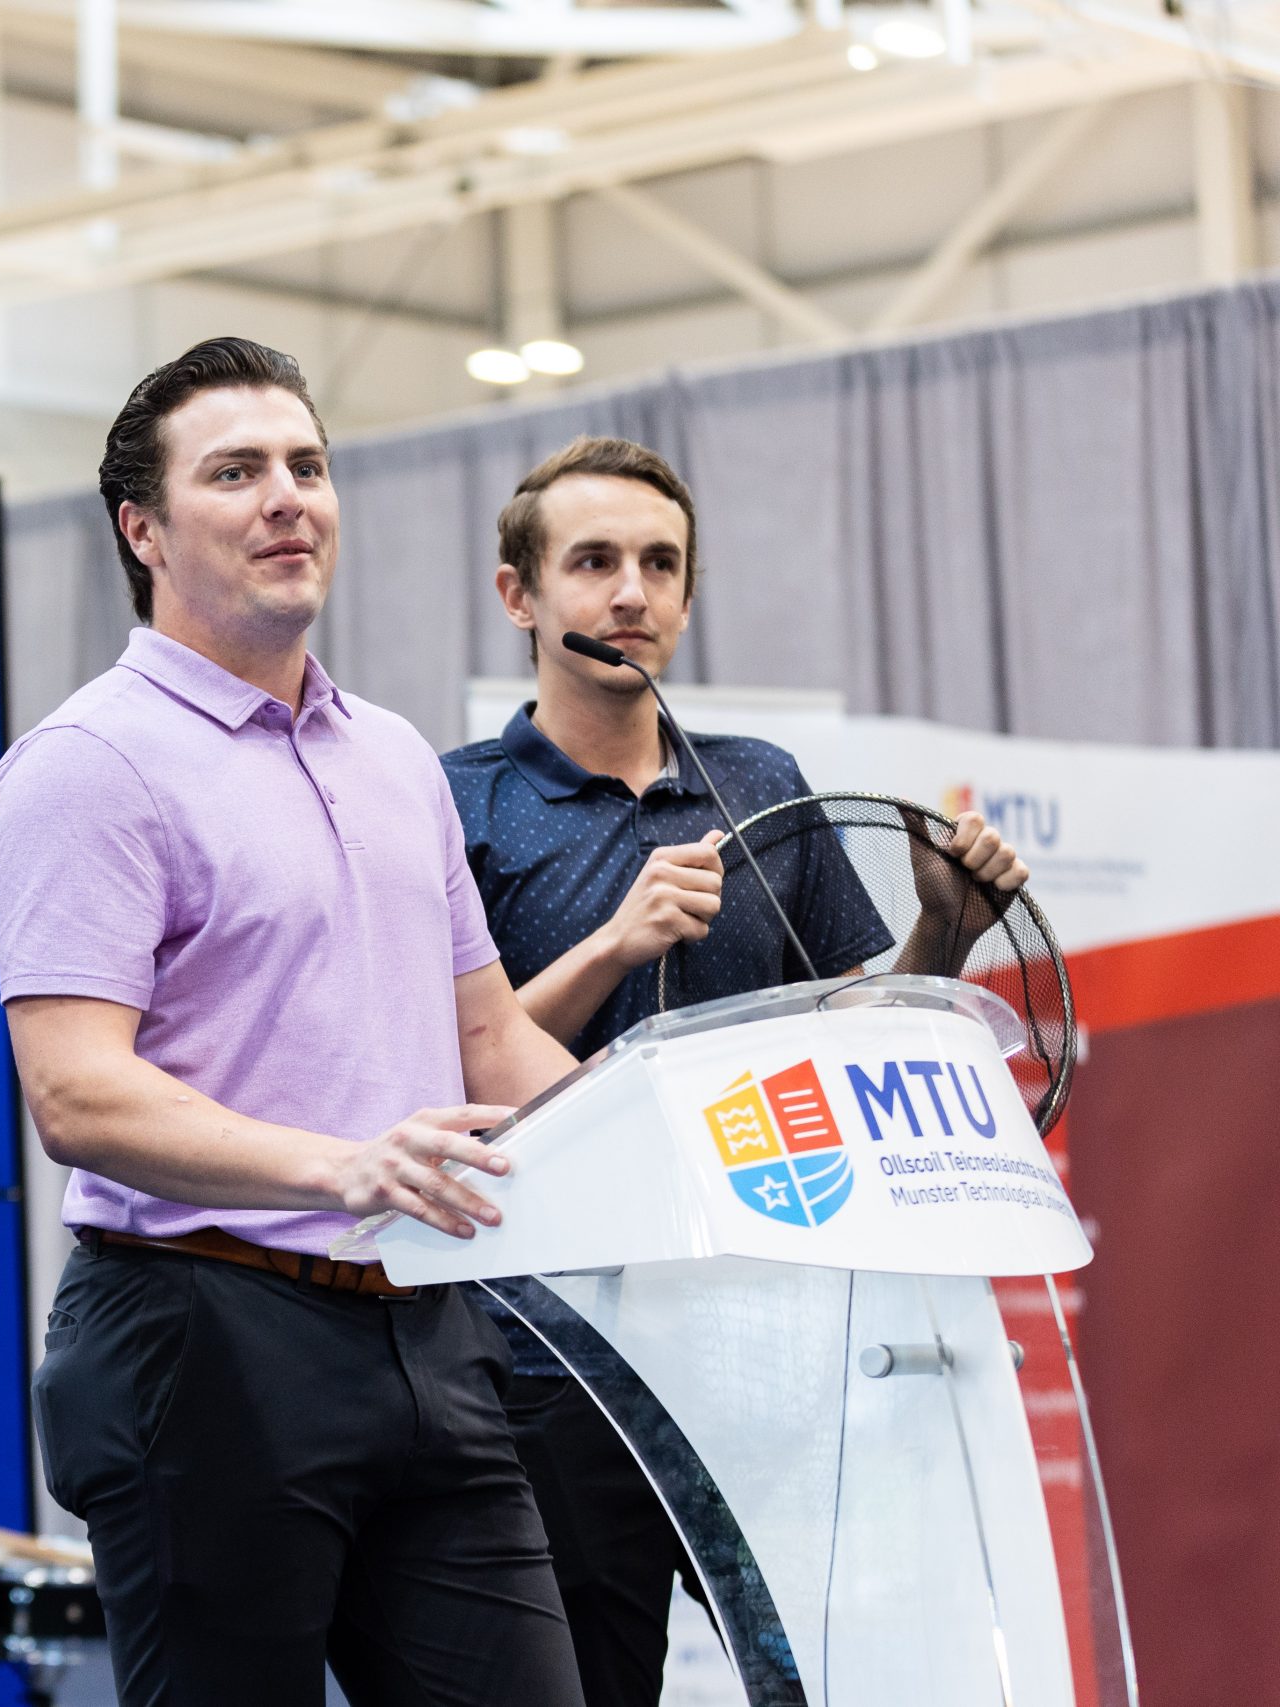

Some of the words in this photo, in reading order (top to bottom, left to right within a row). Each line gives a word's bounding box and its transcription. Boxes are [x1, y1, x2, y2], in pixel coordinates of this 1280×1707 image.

[983, 792, 1060, 848] MTU
[844, 1060, 997, 1141] MTU
[880, 1151, 946, 1176] Ollscoil
[890, 1185, 960, 1207] Munster
[959, 1181, 1043, 1209] Technological
